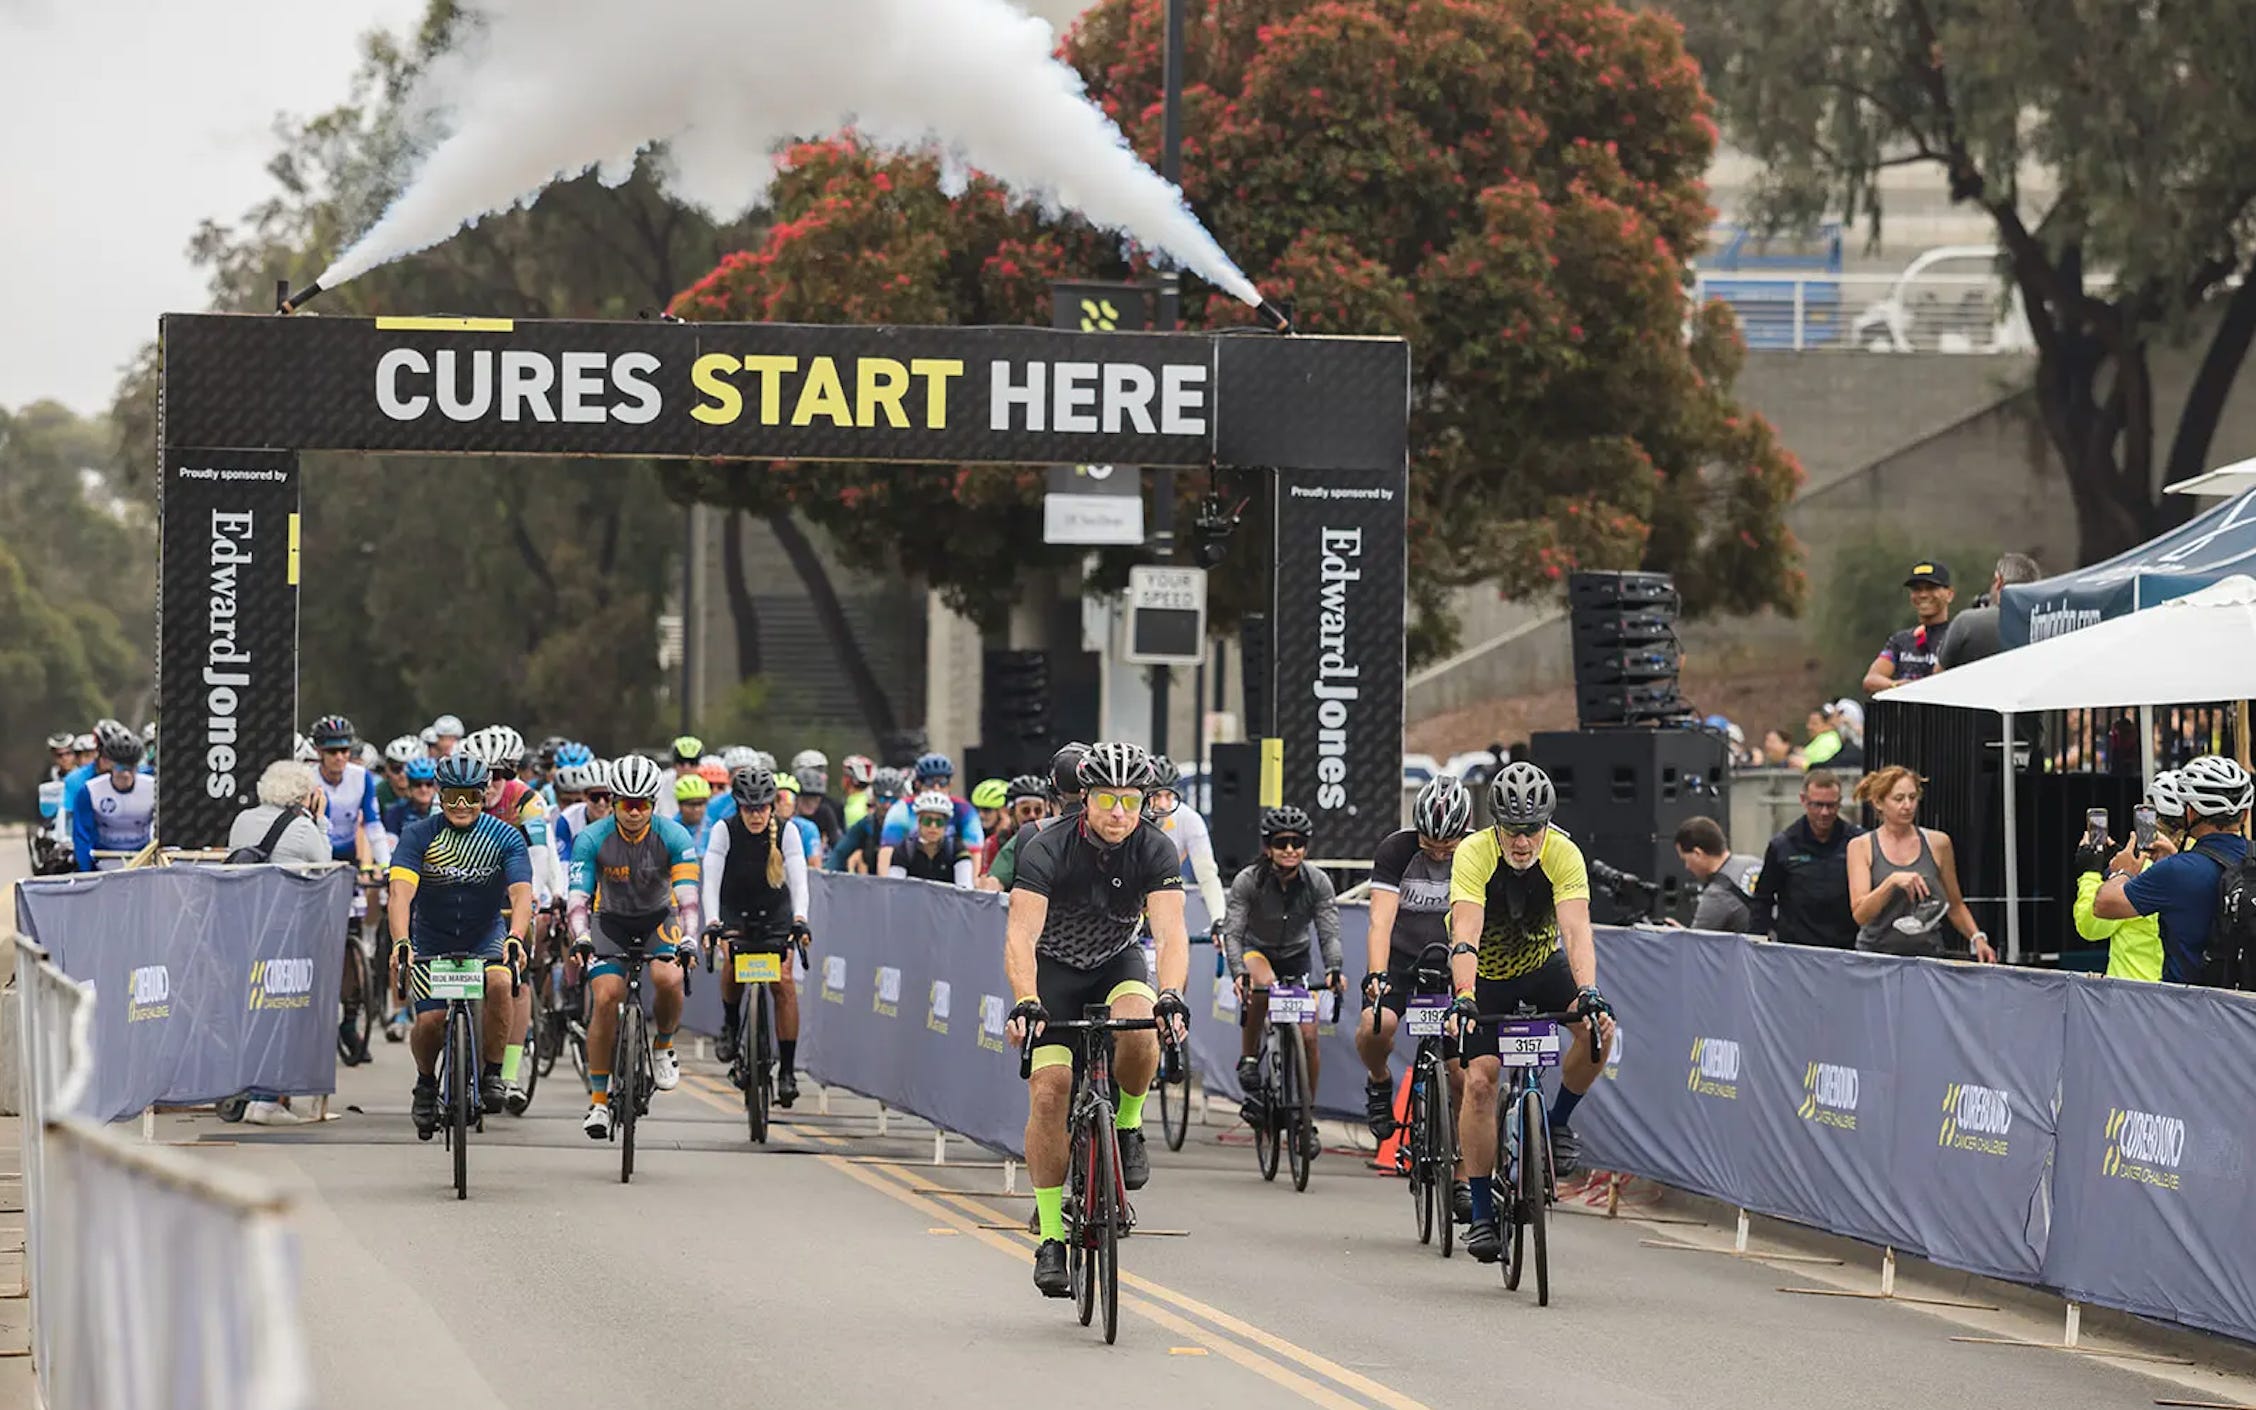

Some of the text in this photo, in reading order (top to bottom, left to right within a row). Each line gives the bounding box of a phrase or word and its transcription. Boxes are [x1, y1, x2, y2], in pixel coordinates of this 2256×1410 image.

[375, 347, 1208, 435] CURES START HERE
[179, 467, 288, 483] Proudly sponsored by
[1291, 486, 1394, 501] Proudly sponsored by
[1146, 574, 1192, 588] YOUR
[1143, 590, 1194, 607] SPEED
[1281, 1000, 1304, 1011] 3312
[1516, 1038, 1542, 1052] 3157
[2120, 1110, 2185, 1168] CUREBOUND
